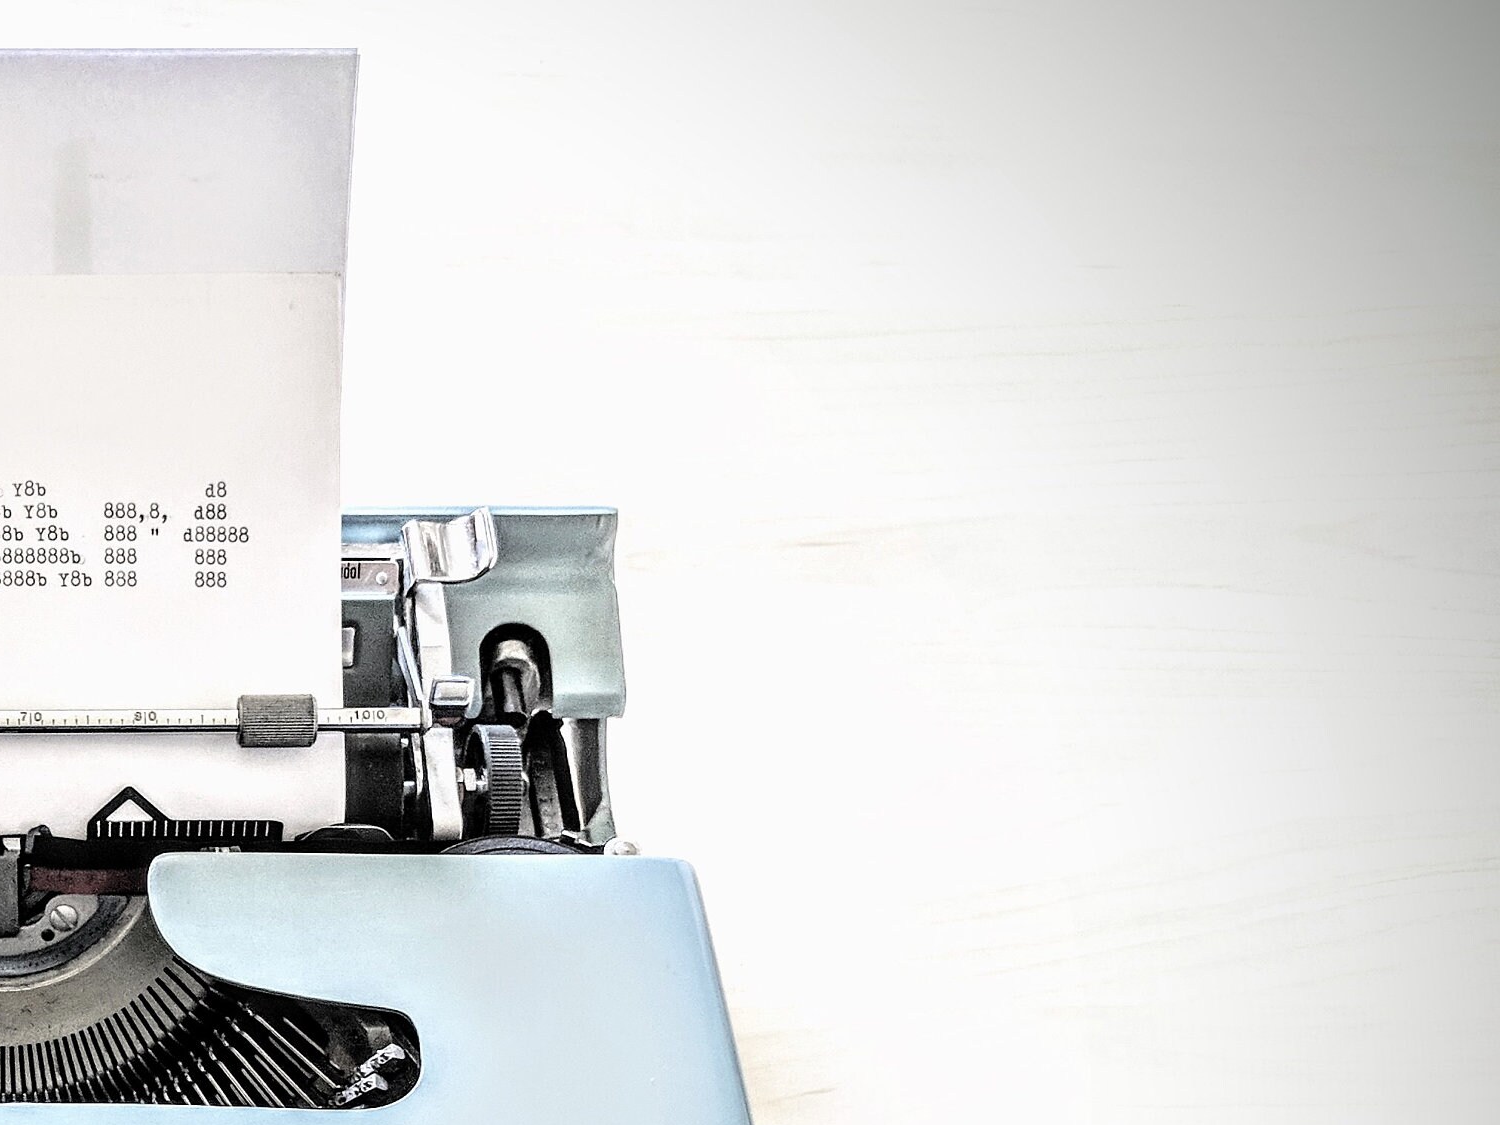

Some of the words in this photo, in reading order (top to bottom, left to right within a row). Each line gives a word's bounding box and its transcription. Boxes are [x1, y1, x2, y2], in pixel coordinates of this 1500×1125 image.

[12, 480, 46, 497] Y8b
[205, 481, 228, 498] d8
[24, 503, 58, 519] Y8b
[194, 503, 227, 520] d88
[35, 525, 69, 541] Y8b
[104, 525, 137, 541] 888
[183, 526, 250, 543] d88888
[104, 548, 137, 564] 888
[195, 549, 227, 565] 888
[58, 570, 92, 587] Y8b
[105, 570, 137, 587] 888
[195, 571, 227, 588] 888
